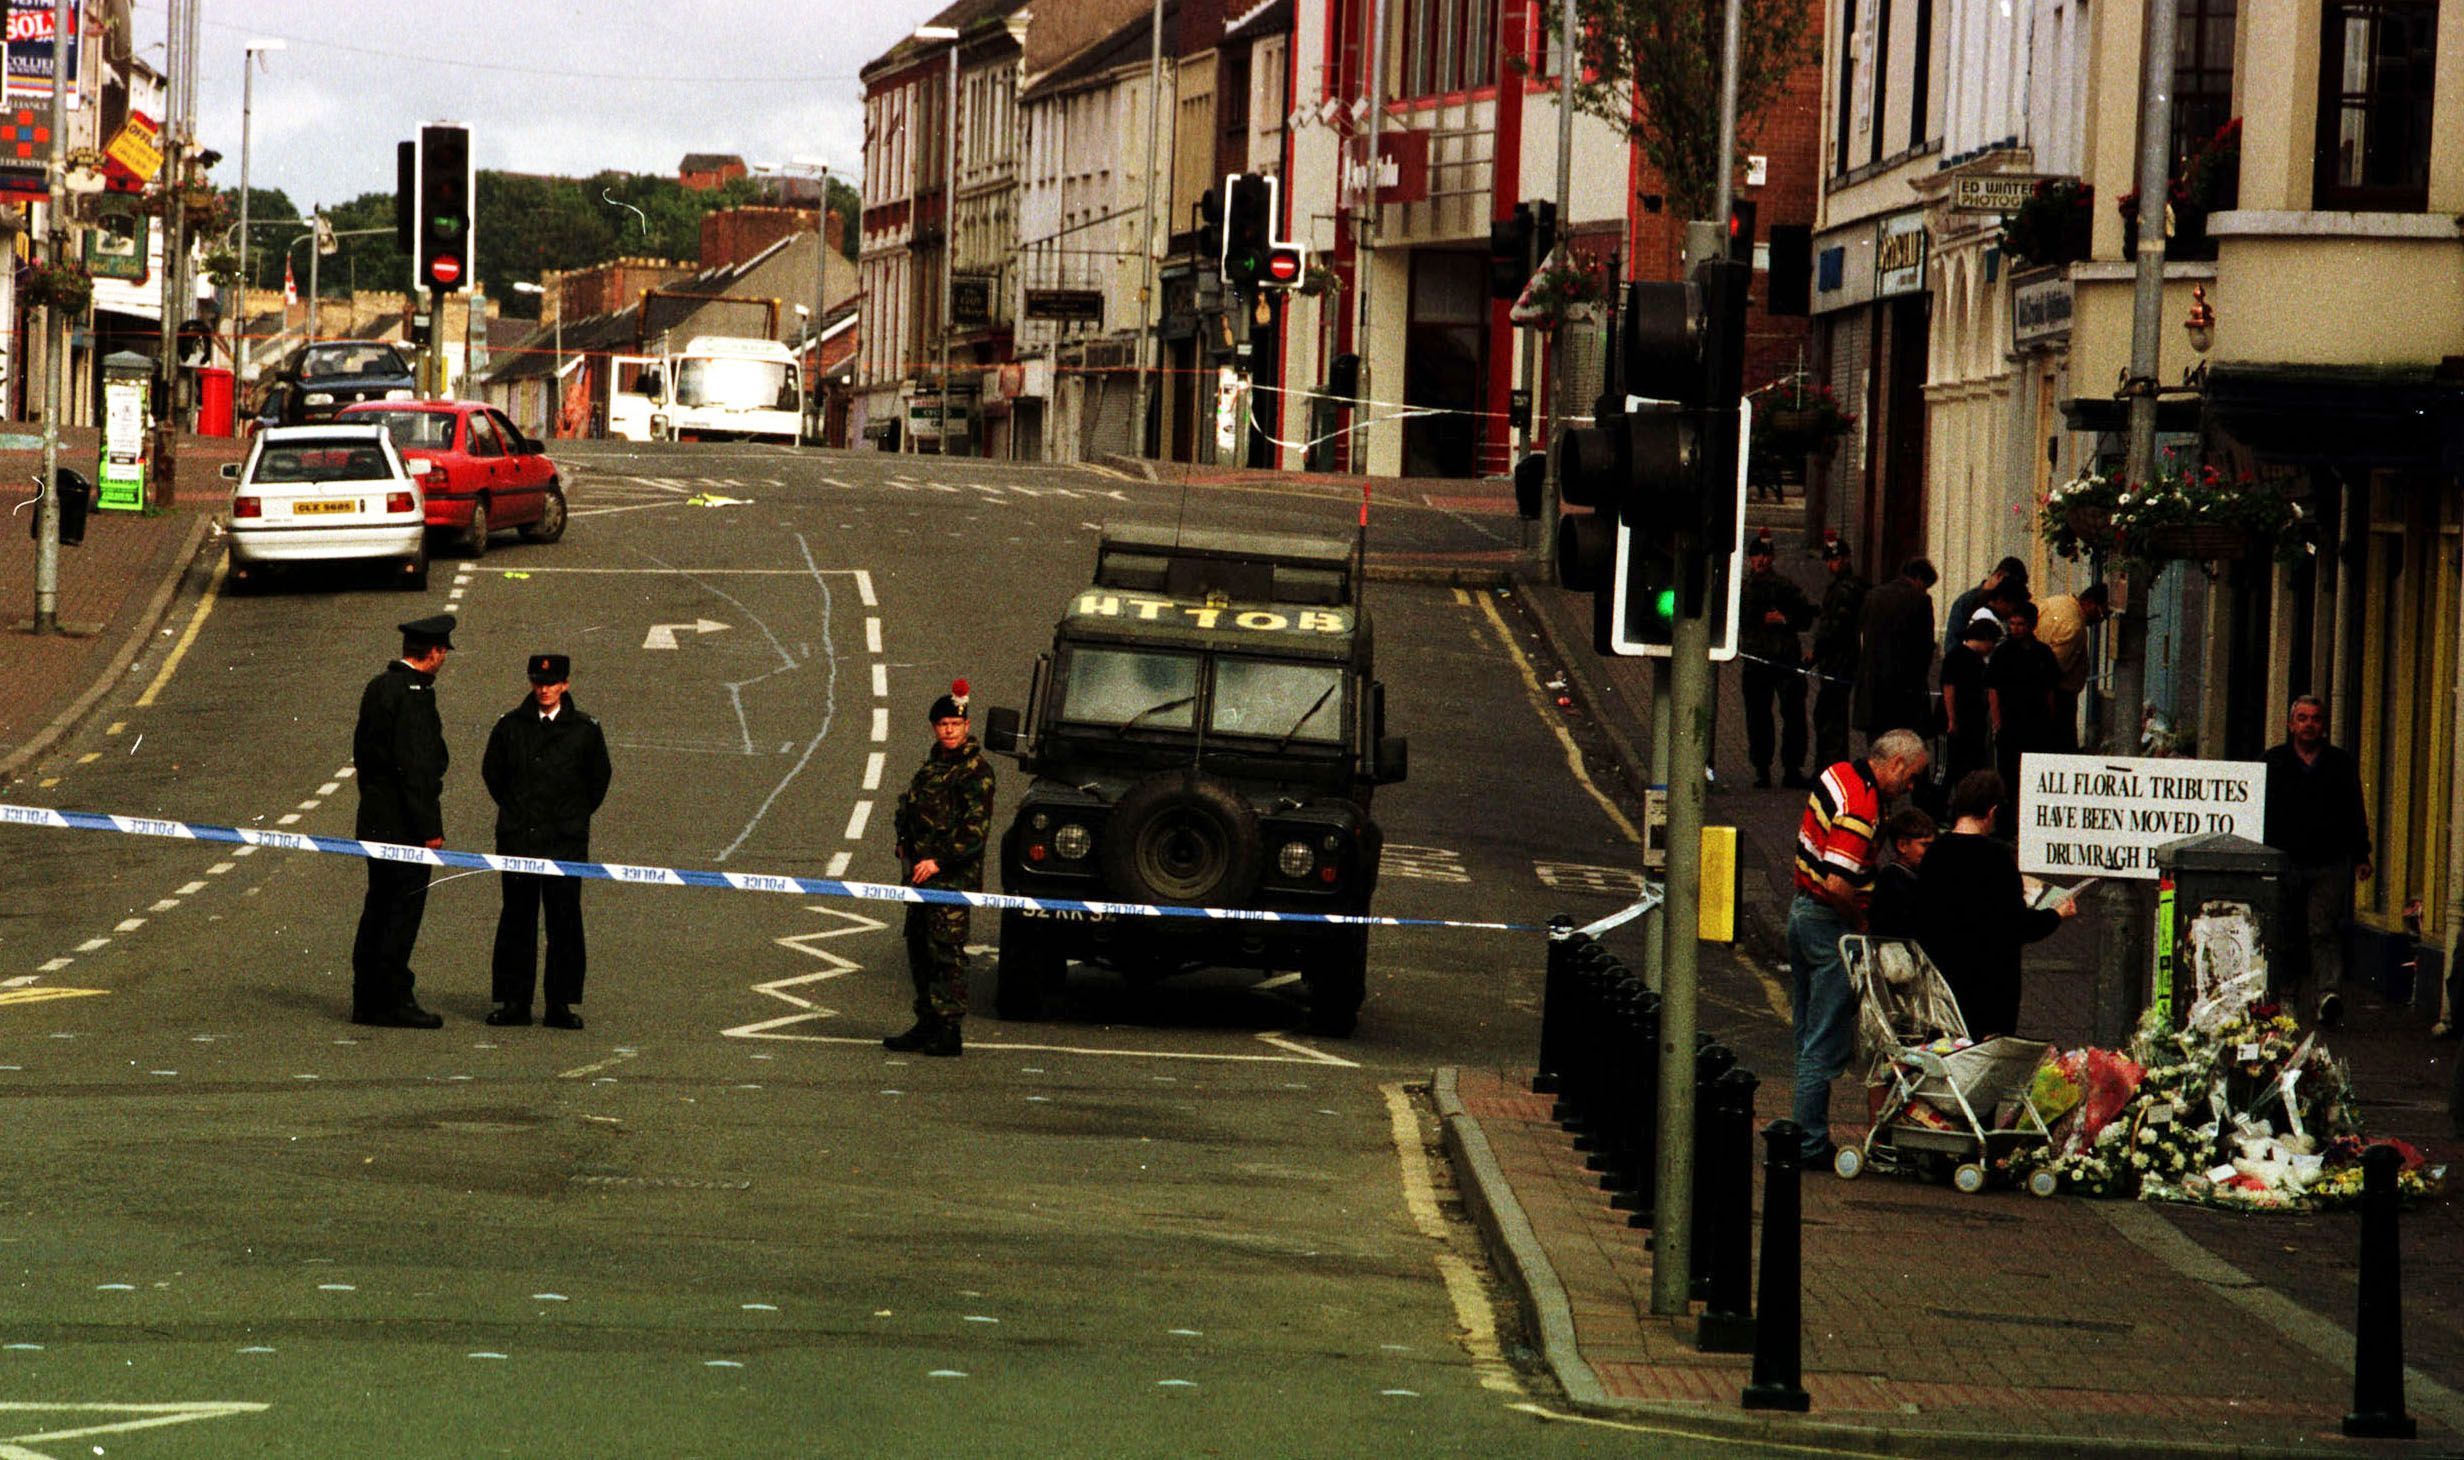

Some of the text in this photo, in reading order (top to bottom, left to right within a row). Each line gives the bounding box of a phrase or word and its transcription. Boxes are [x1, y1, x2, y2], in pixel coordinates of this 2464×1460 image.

[7, 13, 57, 40] SOL
[1962, 181, 1980, 193] ED
[2037, 772, 2249, 803] ALL FLORAL TRIBUTES
[2036, 804, 2234, 834] HAVE BEEN MOVED TO
[3, 808, 49, 823] POLICE
[131, 820, 176, 835] POLICE
[256, 831, 300, 848] POLICE
[380, 846, 424, 861] POLICE
[502, 858, 545, 872] POLICE
[622, 867, 665, 881] POLICE
[743, 876, 785, 890] POLICE
[862, 886, 905, 900] POLICE
[2046, 843, 2140, 869] DRUMRAGH
